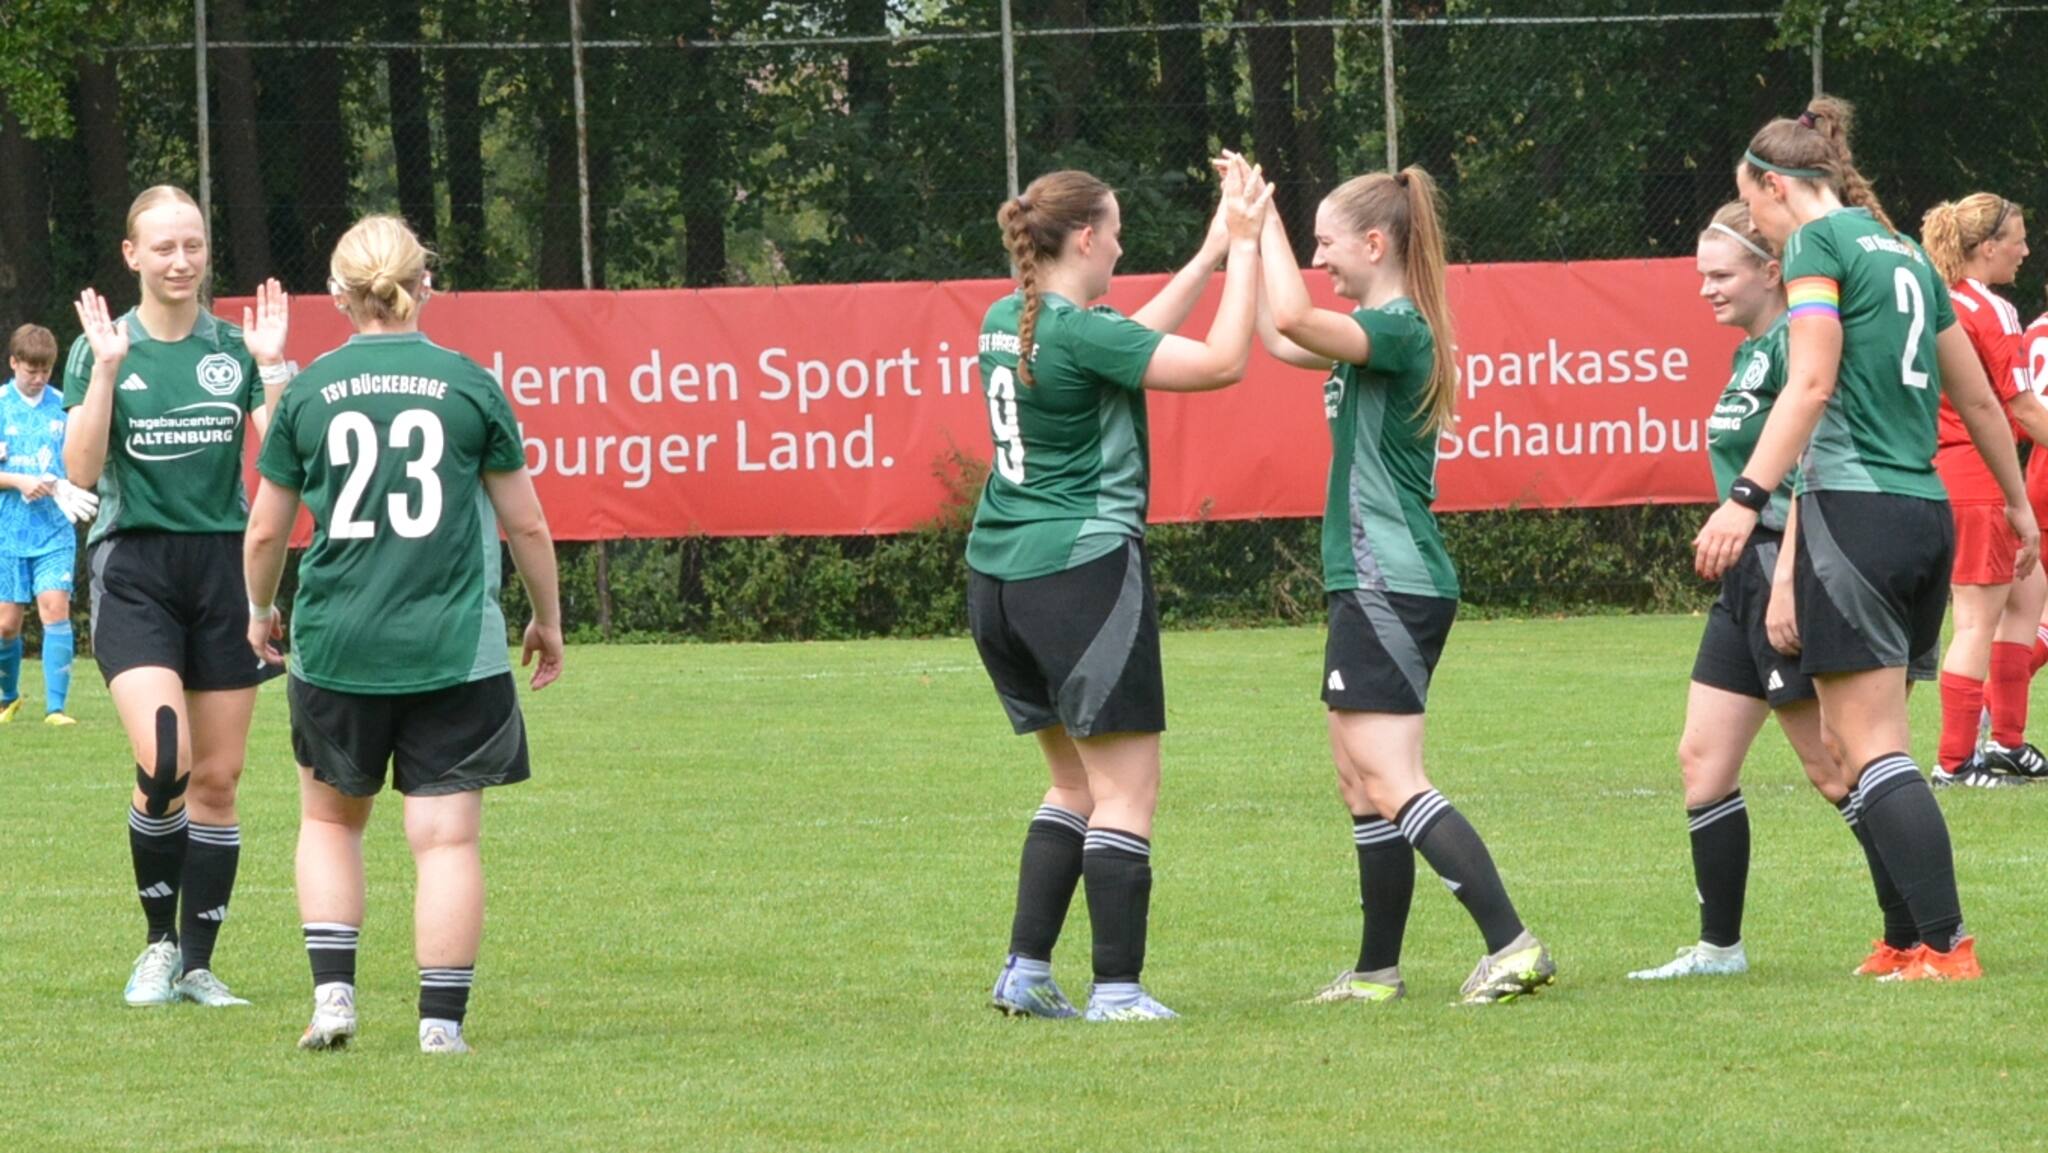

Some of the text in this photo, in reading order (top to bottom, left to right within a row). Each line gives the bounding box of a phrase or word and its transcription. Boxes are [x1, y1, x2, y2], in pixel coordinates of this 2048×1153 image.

[1894, 267, 1929, 389] 2
[320, 372, 449, 404] TSV BÜCKEBERGE
[629, 349, 739, 404] den
[758, 347, 921, 413] Sport
[128, 414, 234, 431] hagebaucentrum
[132, 429, 233, 446] ALTENBURG
[737, 414, 895, 472] Land.
[987, 365, 1025, 485] 9
[1437, 407, 1709, 460] Schaumbu
[327, 408, 444, 539] 23
